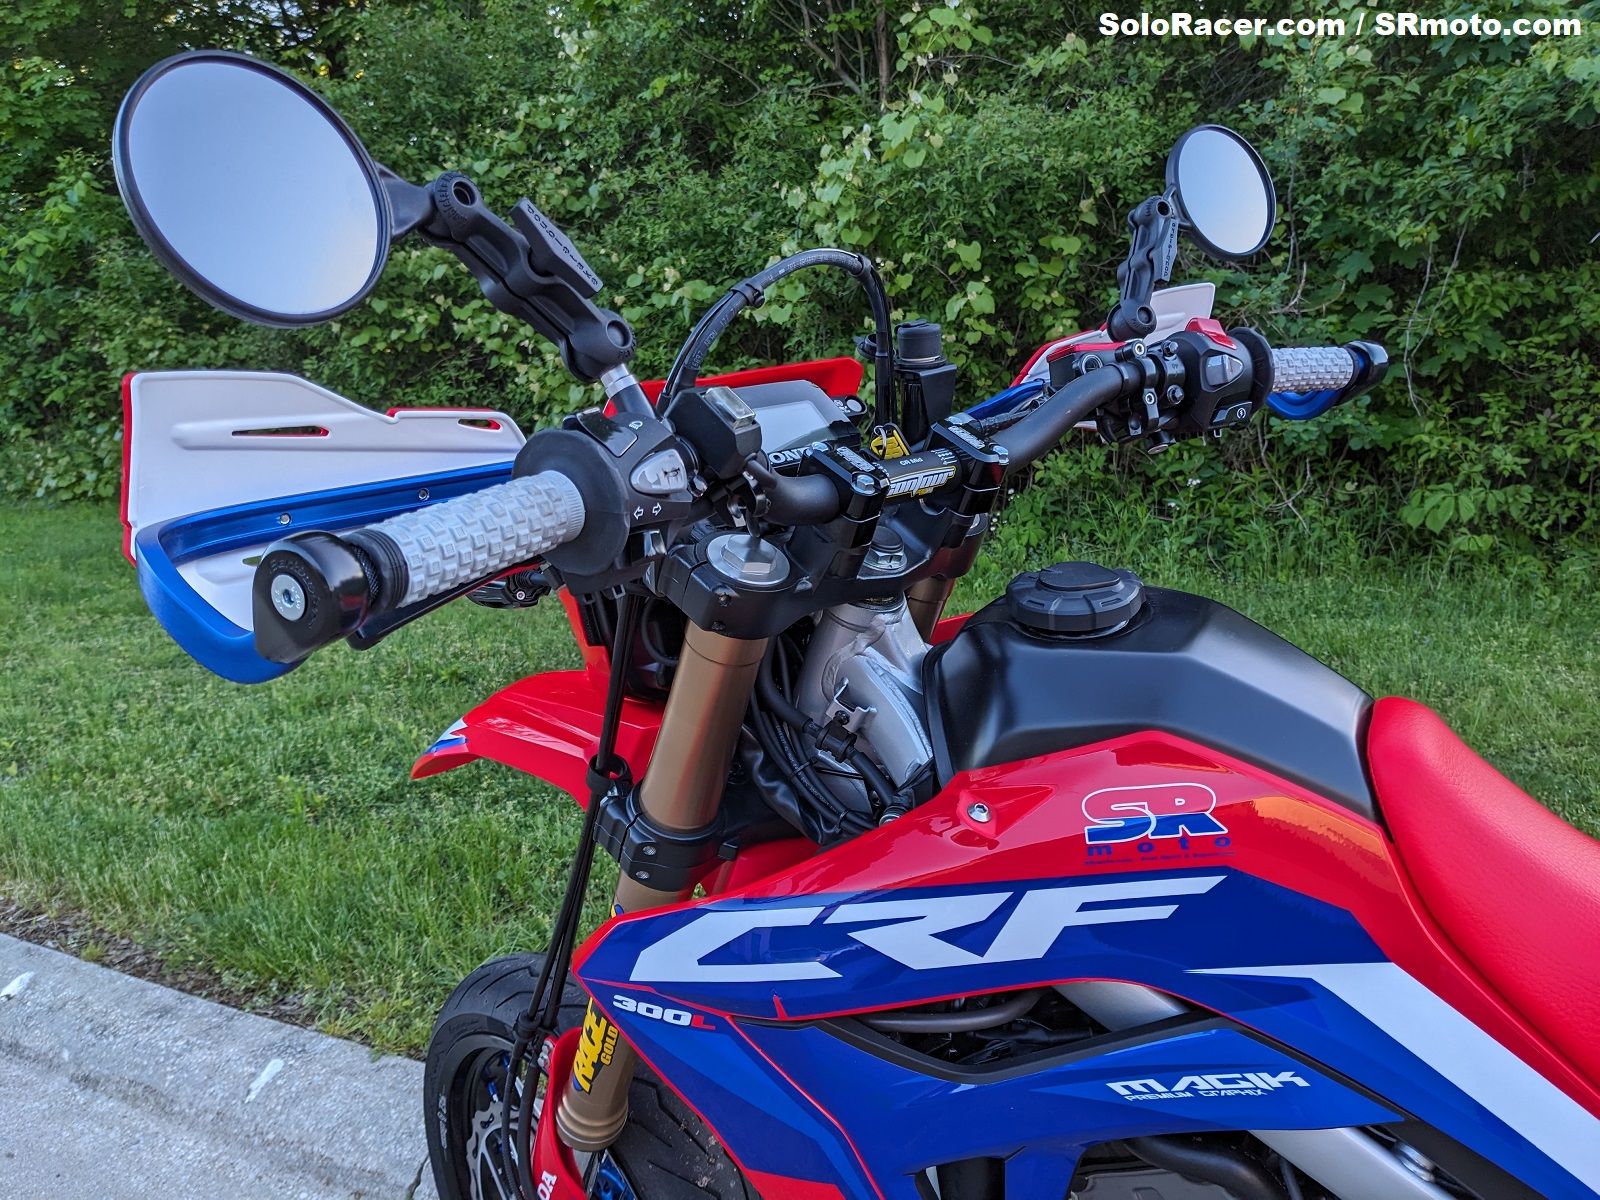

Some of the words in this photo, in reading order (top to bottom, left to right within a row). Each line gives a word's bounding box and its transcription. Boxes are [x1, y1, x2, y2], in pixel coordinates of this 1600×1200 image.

[1081, 782, 1229, 845] SR
[1087, 836, 1231, 857] moto
[629, 875, 1228, 982] CRF
[612, 994, 716, 1027] 300L
[600, 1025, 619, 1066] GOLD
[1106, 1071, 1311, 1096] MAGIK
[1124, 1091, 1195, 1102] PREMIUM
